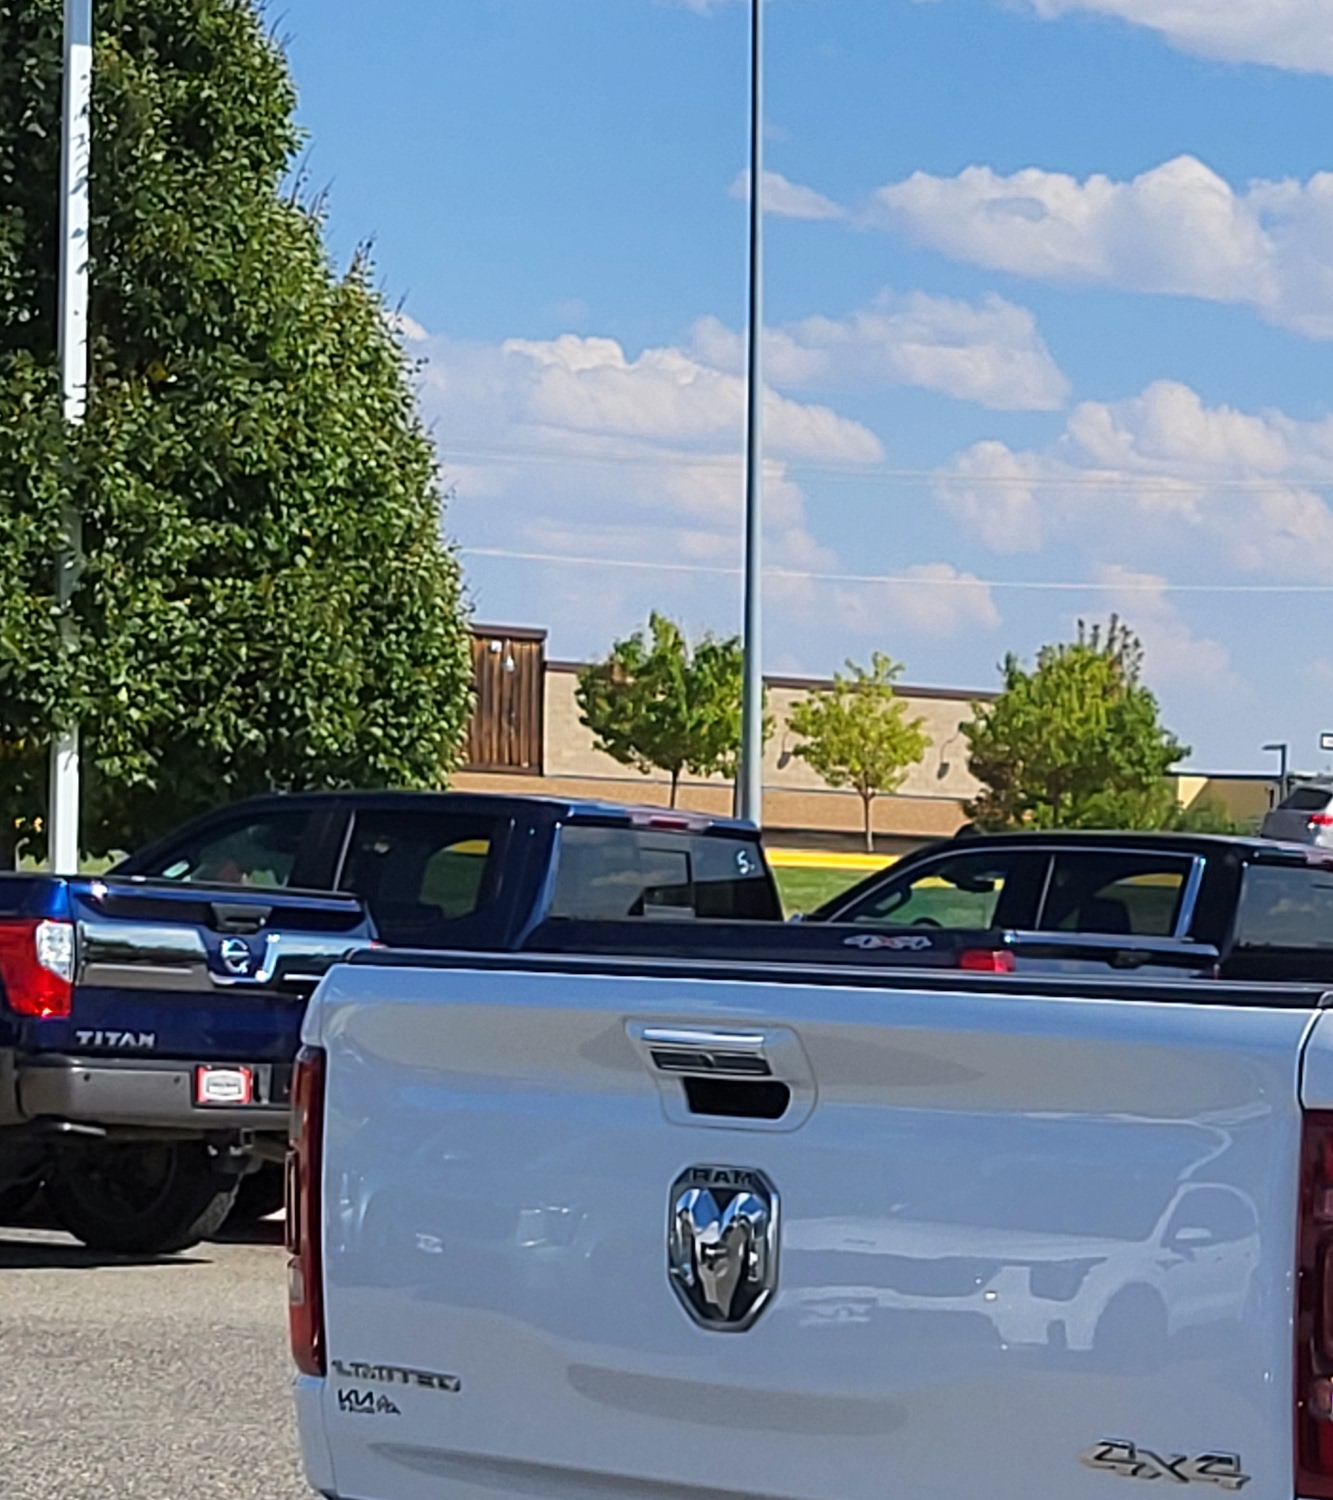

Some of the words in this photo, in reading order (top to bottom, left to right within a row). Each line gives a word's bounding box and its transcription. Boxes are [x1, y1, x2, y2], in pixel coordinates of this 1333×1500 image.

[75, 1030, 155, 1047] TITAN
[690, 1168, 752, 1184] RAM
[331, 1359, 461, 1392] LIMITED
